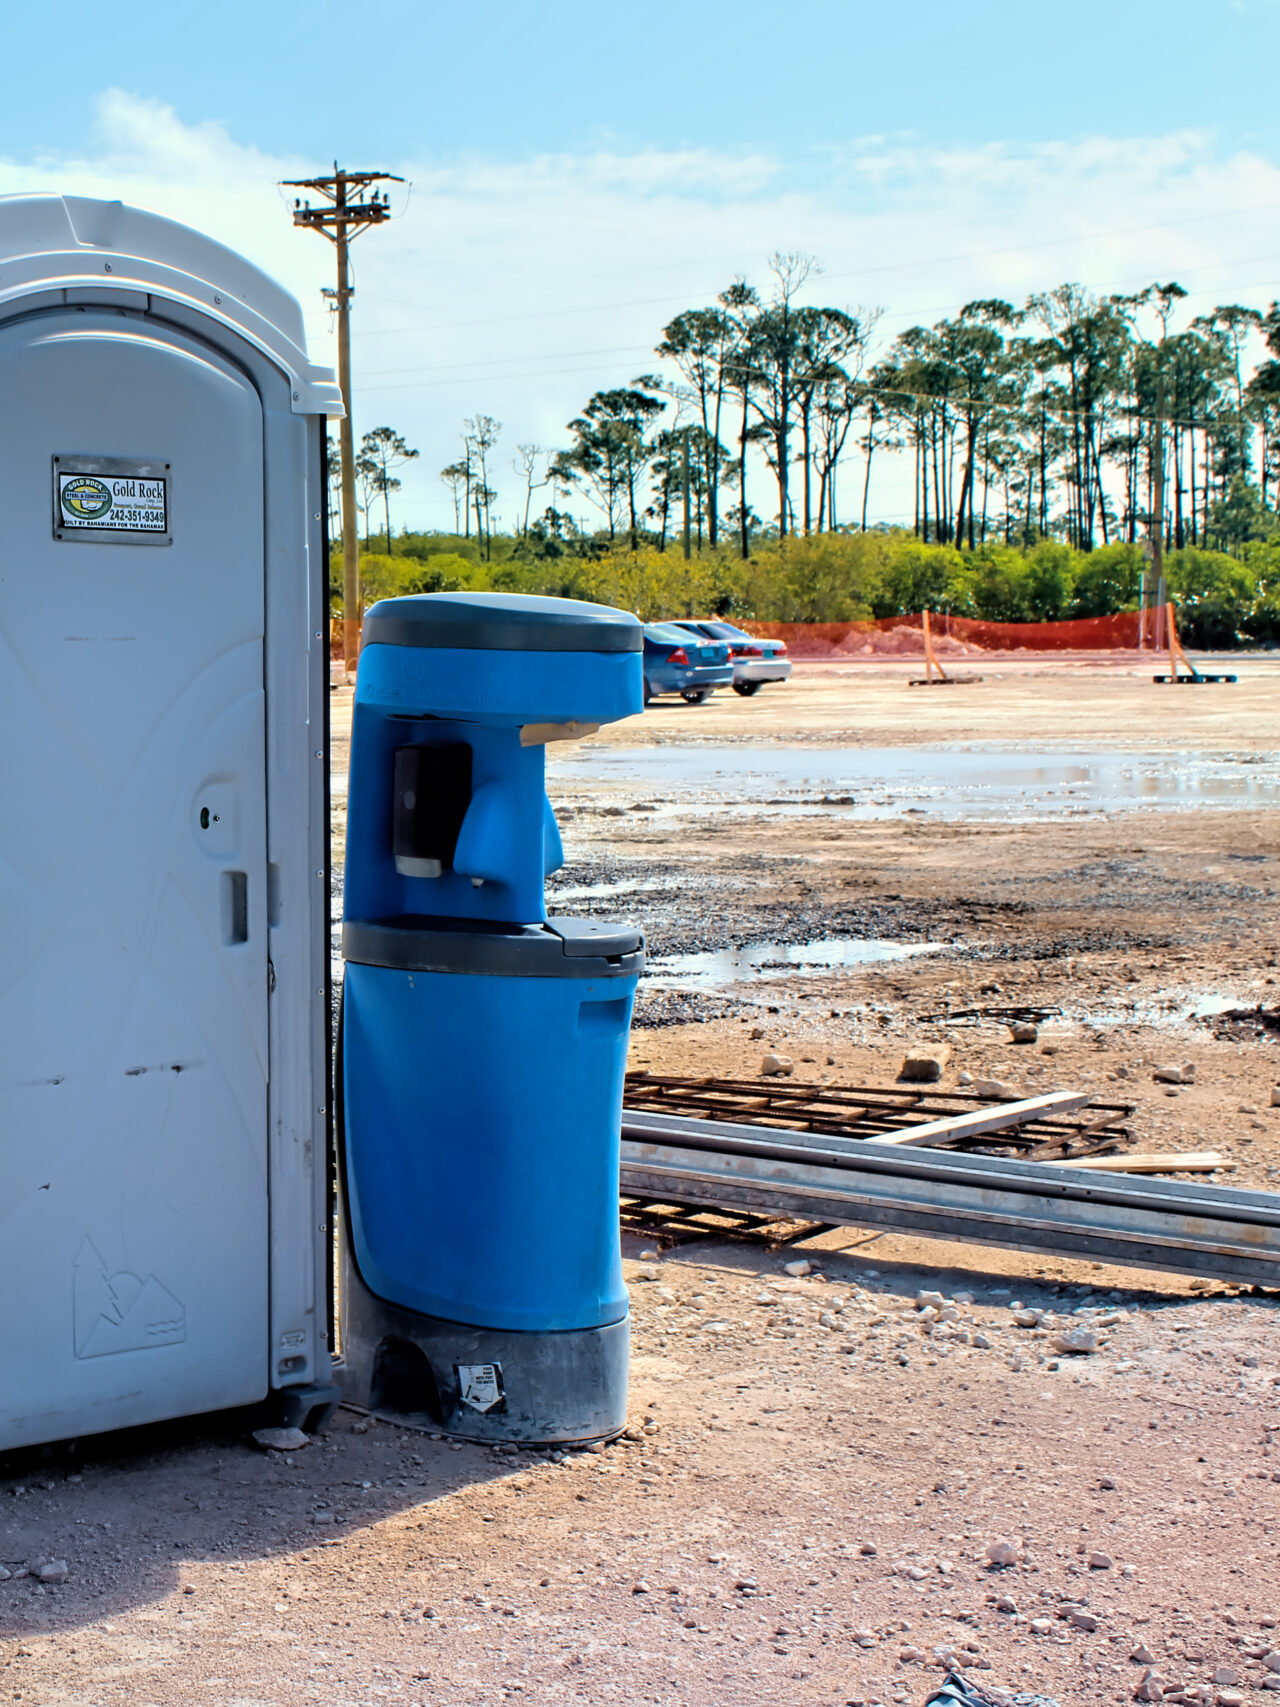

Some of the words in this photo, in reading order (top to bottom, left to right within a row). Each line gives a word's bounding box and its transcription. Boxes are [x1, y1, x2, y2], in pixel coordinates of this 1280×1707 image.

[68, 480, 85, 490] GOLD
[85, 480, 103, 490] ROCK
[112, 481, 136, 497] Gold
[139, 482, 163, 499] Rock
[109, 509, 164, 523] 242-351-9349
